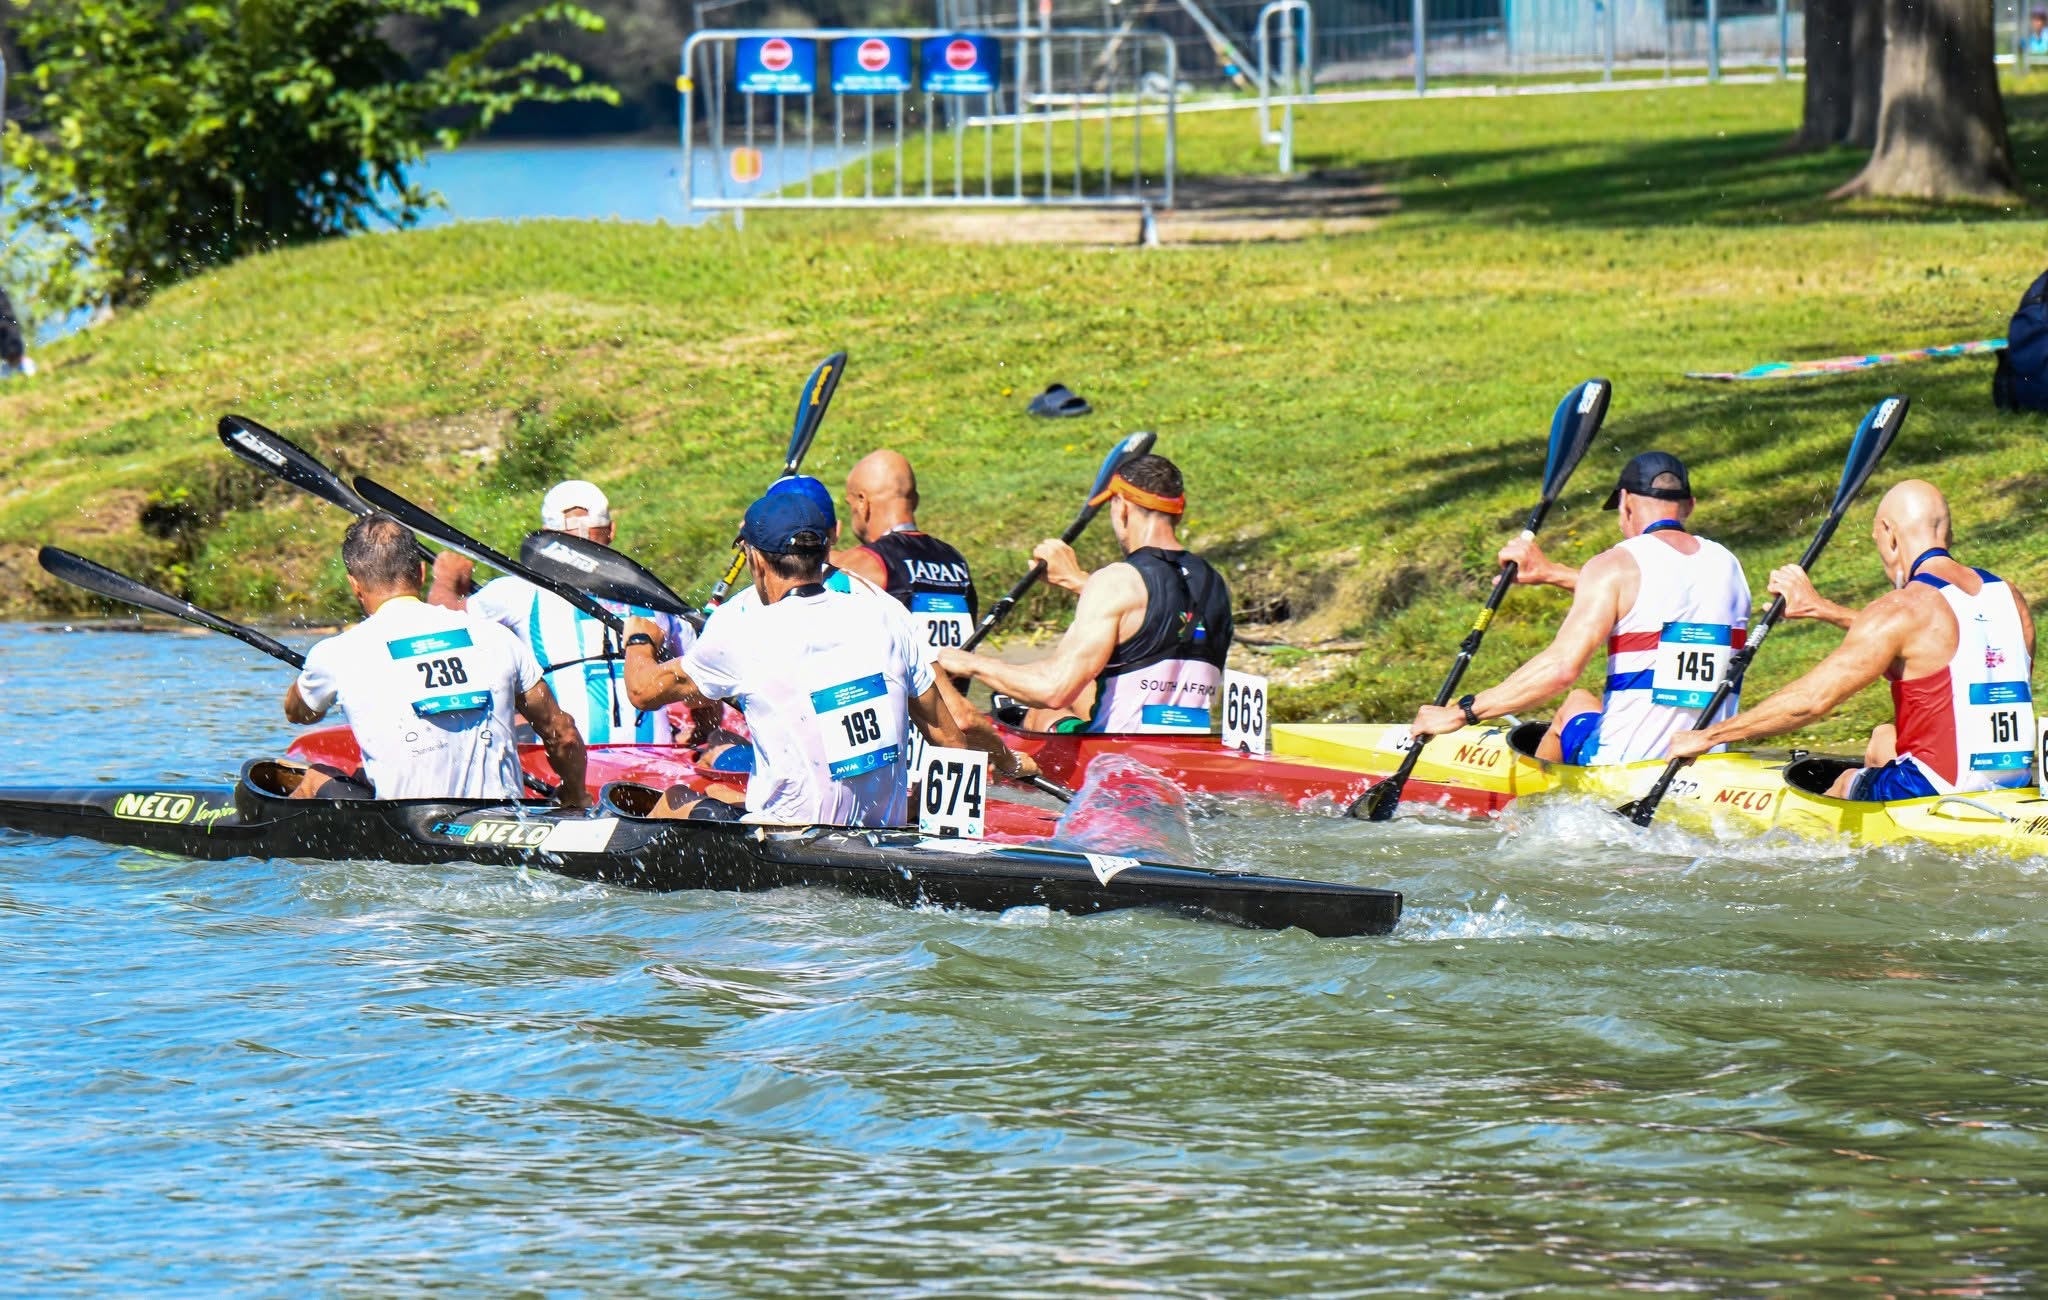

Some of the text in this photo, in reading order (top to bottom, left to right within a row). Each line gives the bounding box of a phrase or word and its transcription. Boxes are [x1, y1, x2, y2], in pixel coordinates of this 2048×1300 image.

[903, 559, 969, 584] JAPAN
[927, 620, 961, 647] 203
[416, 656, 468, 689] 238
[1677, 651, 1715, 682] 145
[1140, 679, 1177, 692] SOUTH
[1227, 682, 1264, 738] 663
[841, 707, 881, 747] 193
[1990, 711, 2019, 743] 151
[1454, 744, 1501, 768] NELO
[925, 759, 982, 818] 674
[1713, 789, 1773, 811] NELO
[117, 793, 192, 819] NELO
[467, 822, 549, 844] NELO
